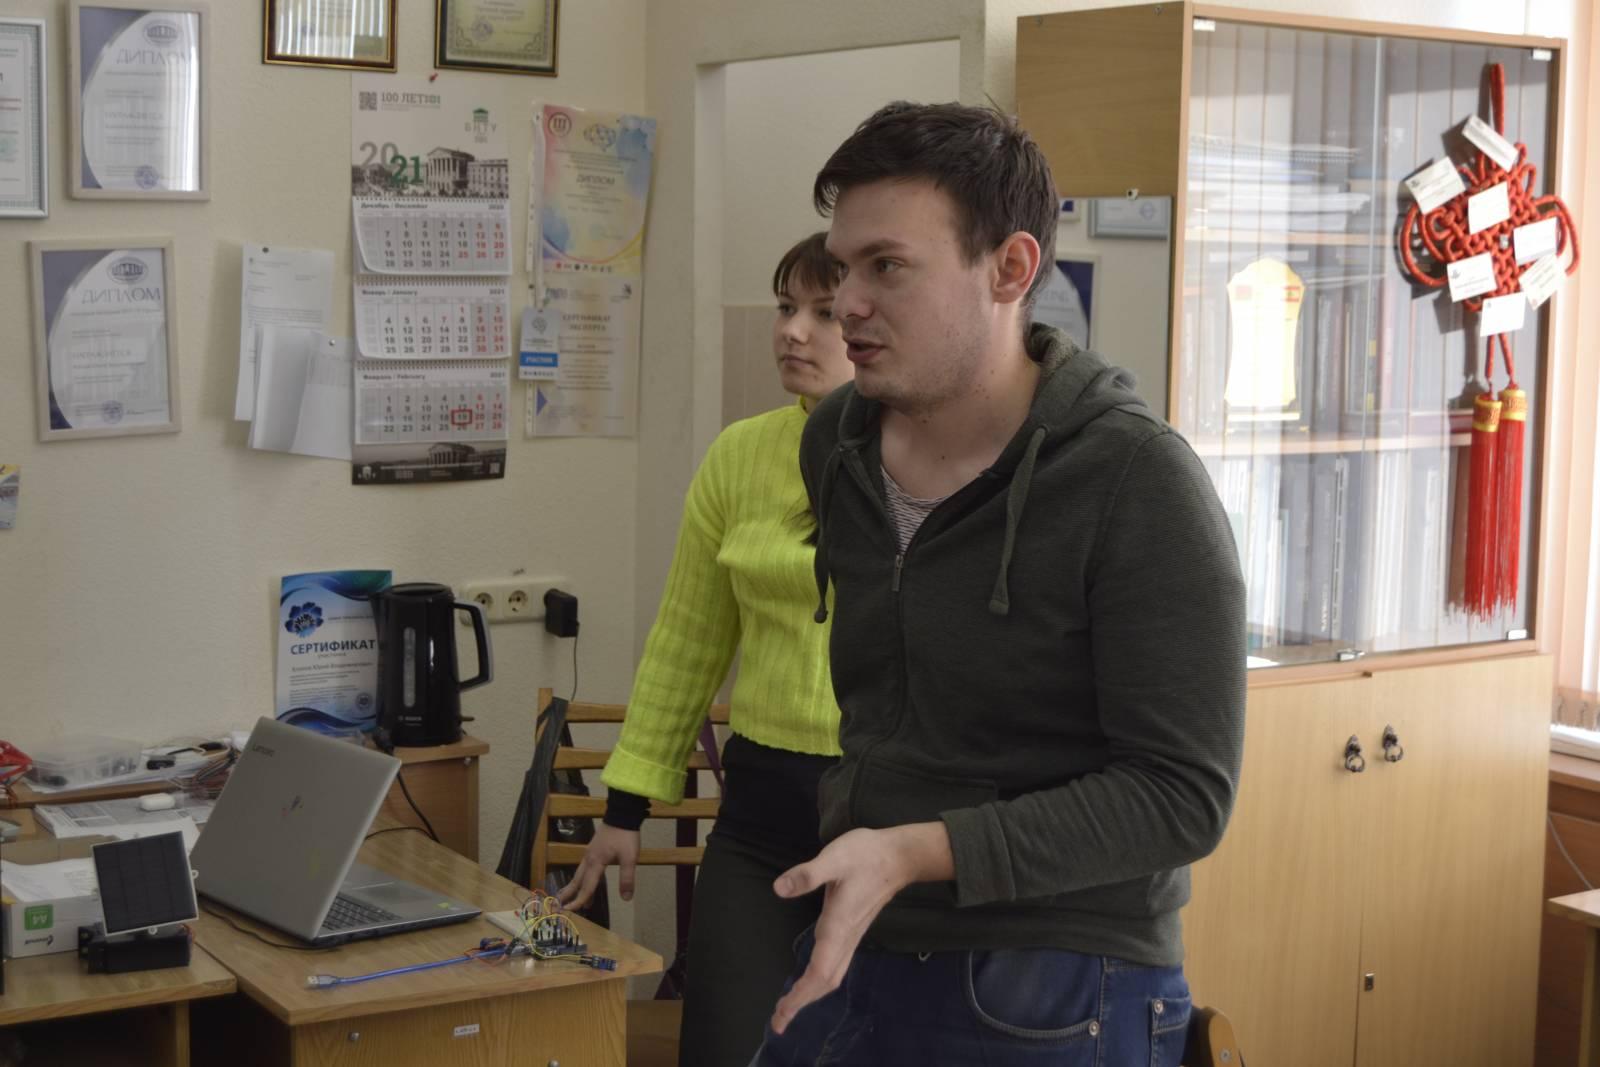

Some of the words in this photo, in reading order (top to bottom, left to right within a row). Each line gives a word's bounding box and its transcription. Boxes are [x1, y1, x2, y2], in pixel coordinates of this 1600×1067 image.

[390, 155, 424, 185] 21
[81, 287, 161, 304] ДИПЛОМ
[290, 639, 376, 655] СЕРТИФИКАТ
